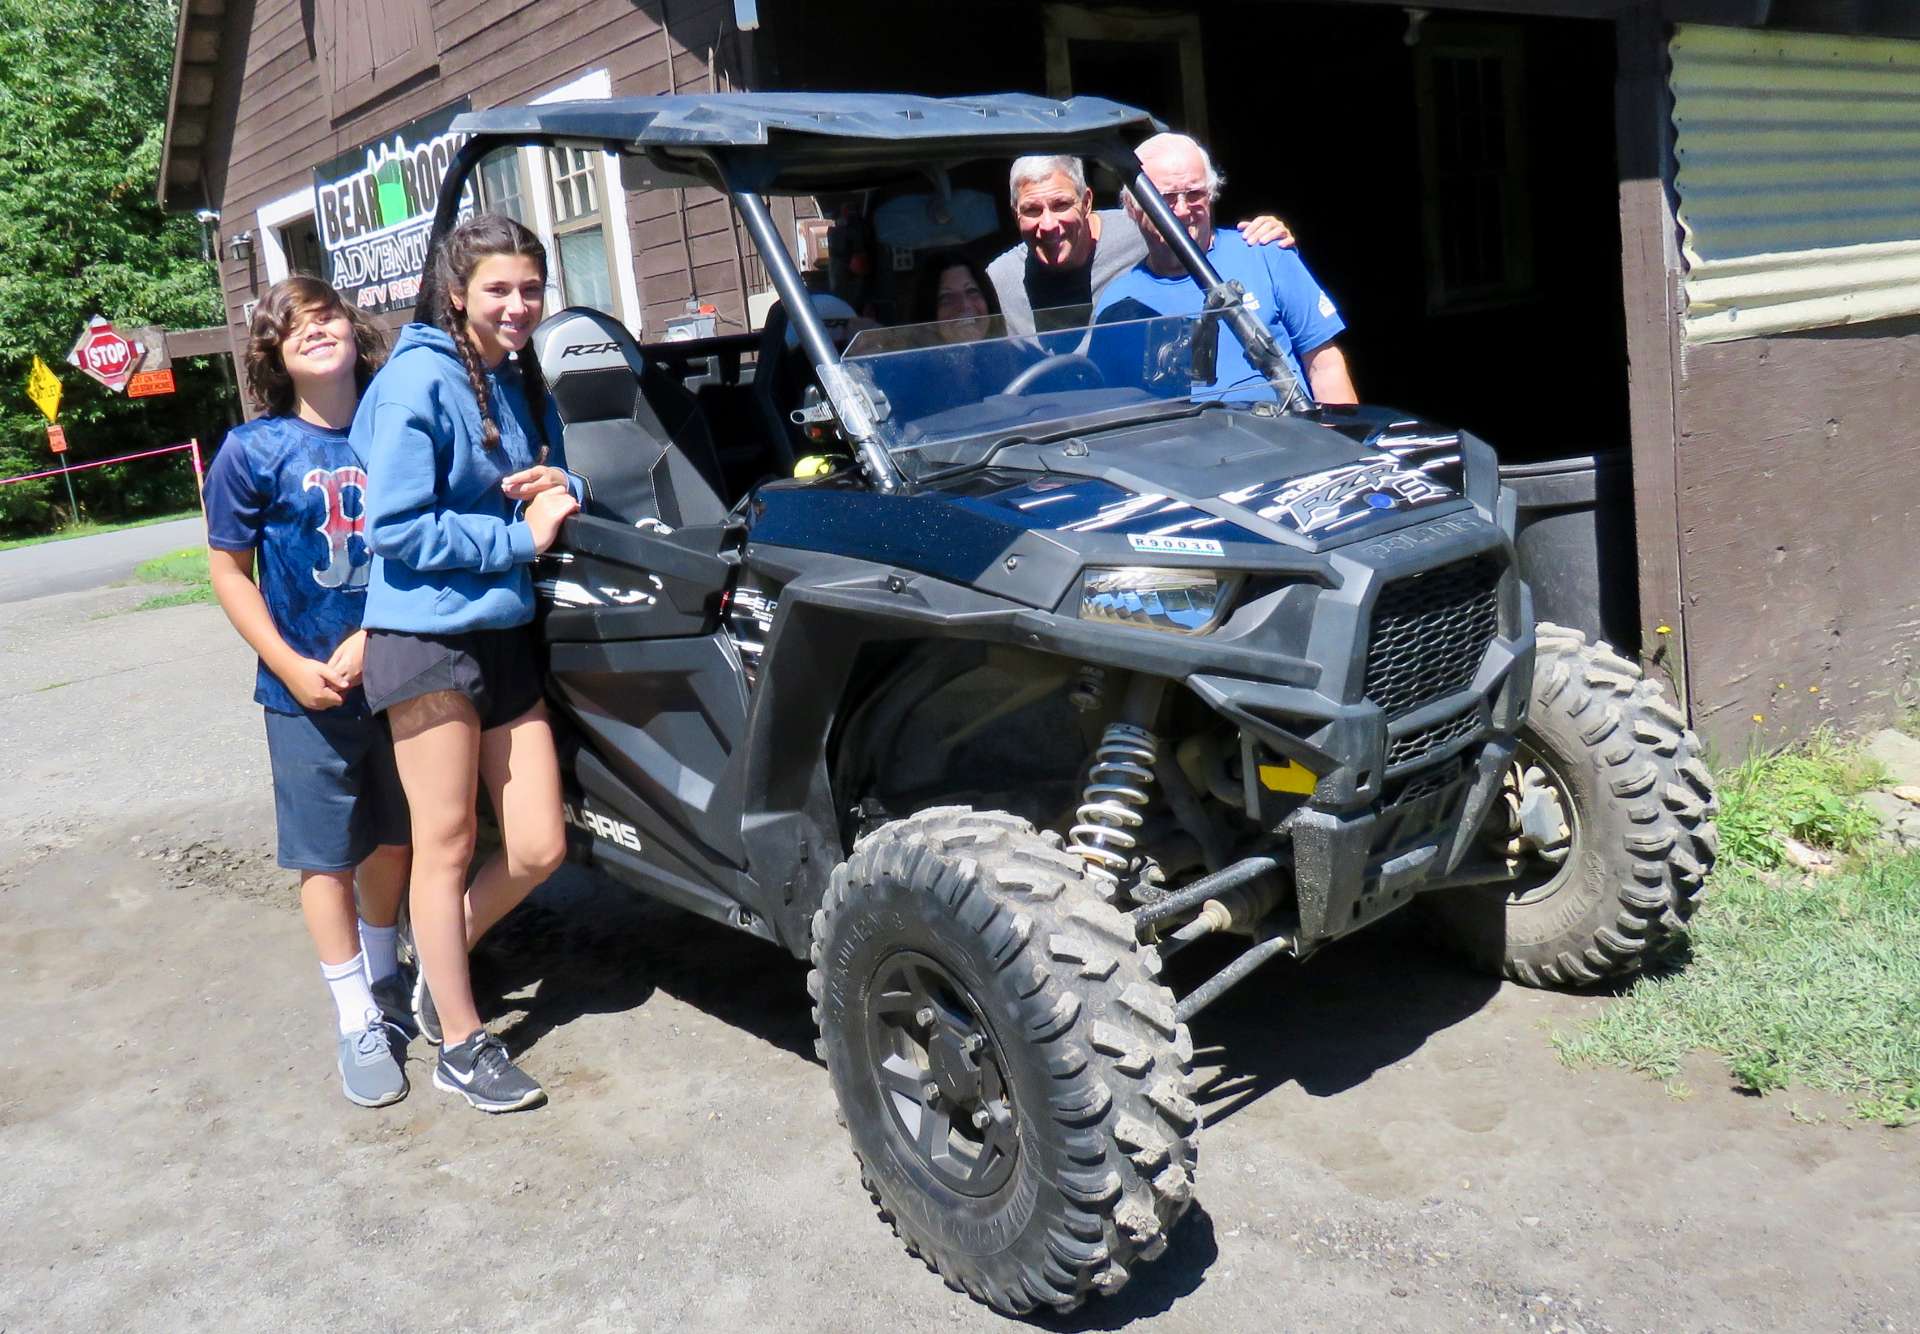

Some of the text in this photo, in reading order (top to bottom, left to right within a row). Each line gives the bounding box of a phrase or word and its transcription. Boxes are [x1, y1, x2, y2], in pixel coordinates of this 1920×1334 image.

[321, 173, 385, 247] BEAR
[357, 284, 387, 308] ATV
[89, 341, 127, 368] STOP
[561, 341, 624, 359] RZR
[1287, 461, 1400, 533] RZR
[562, 801, 642, 852] LARIS
